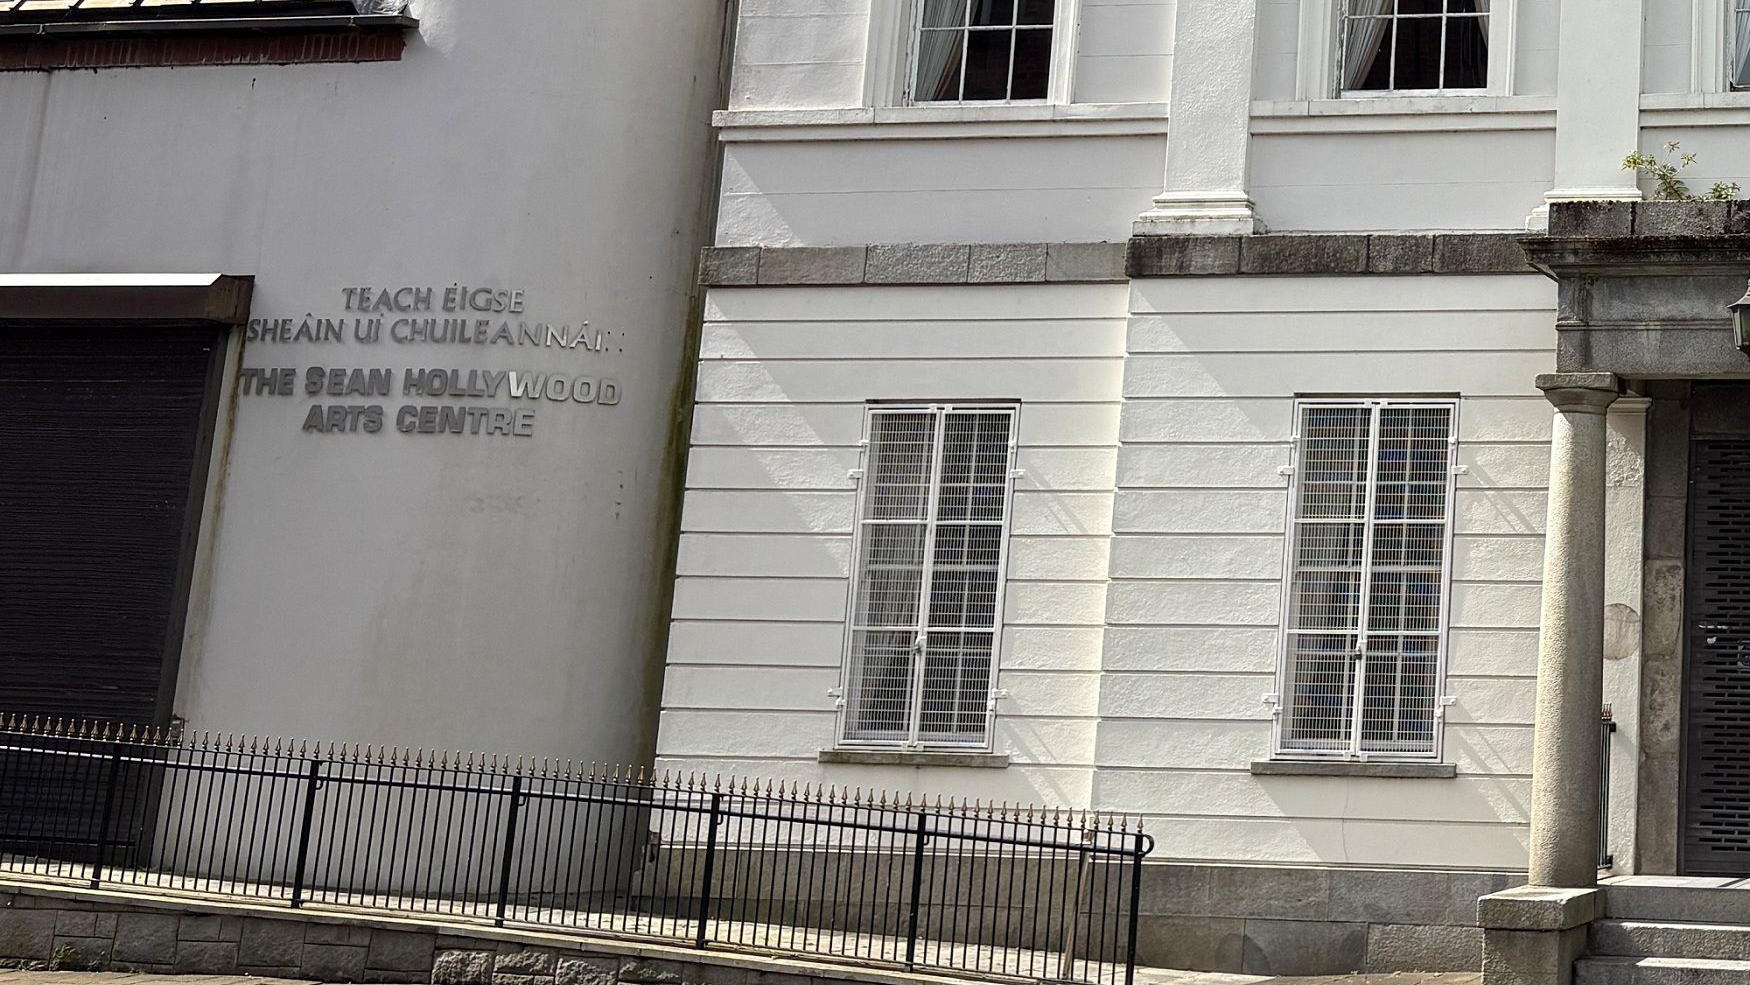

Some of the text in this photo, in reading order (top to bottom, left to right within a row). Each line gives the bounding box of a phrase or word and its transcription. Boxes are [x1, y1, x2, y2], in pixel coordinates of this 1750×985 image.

[342, 287, 433, 313] TEACH
[241, 366, 622, 406] THE SEAN HOLLYWOOD
[302, 405, 536, 438] ARTS CENTRE
